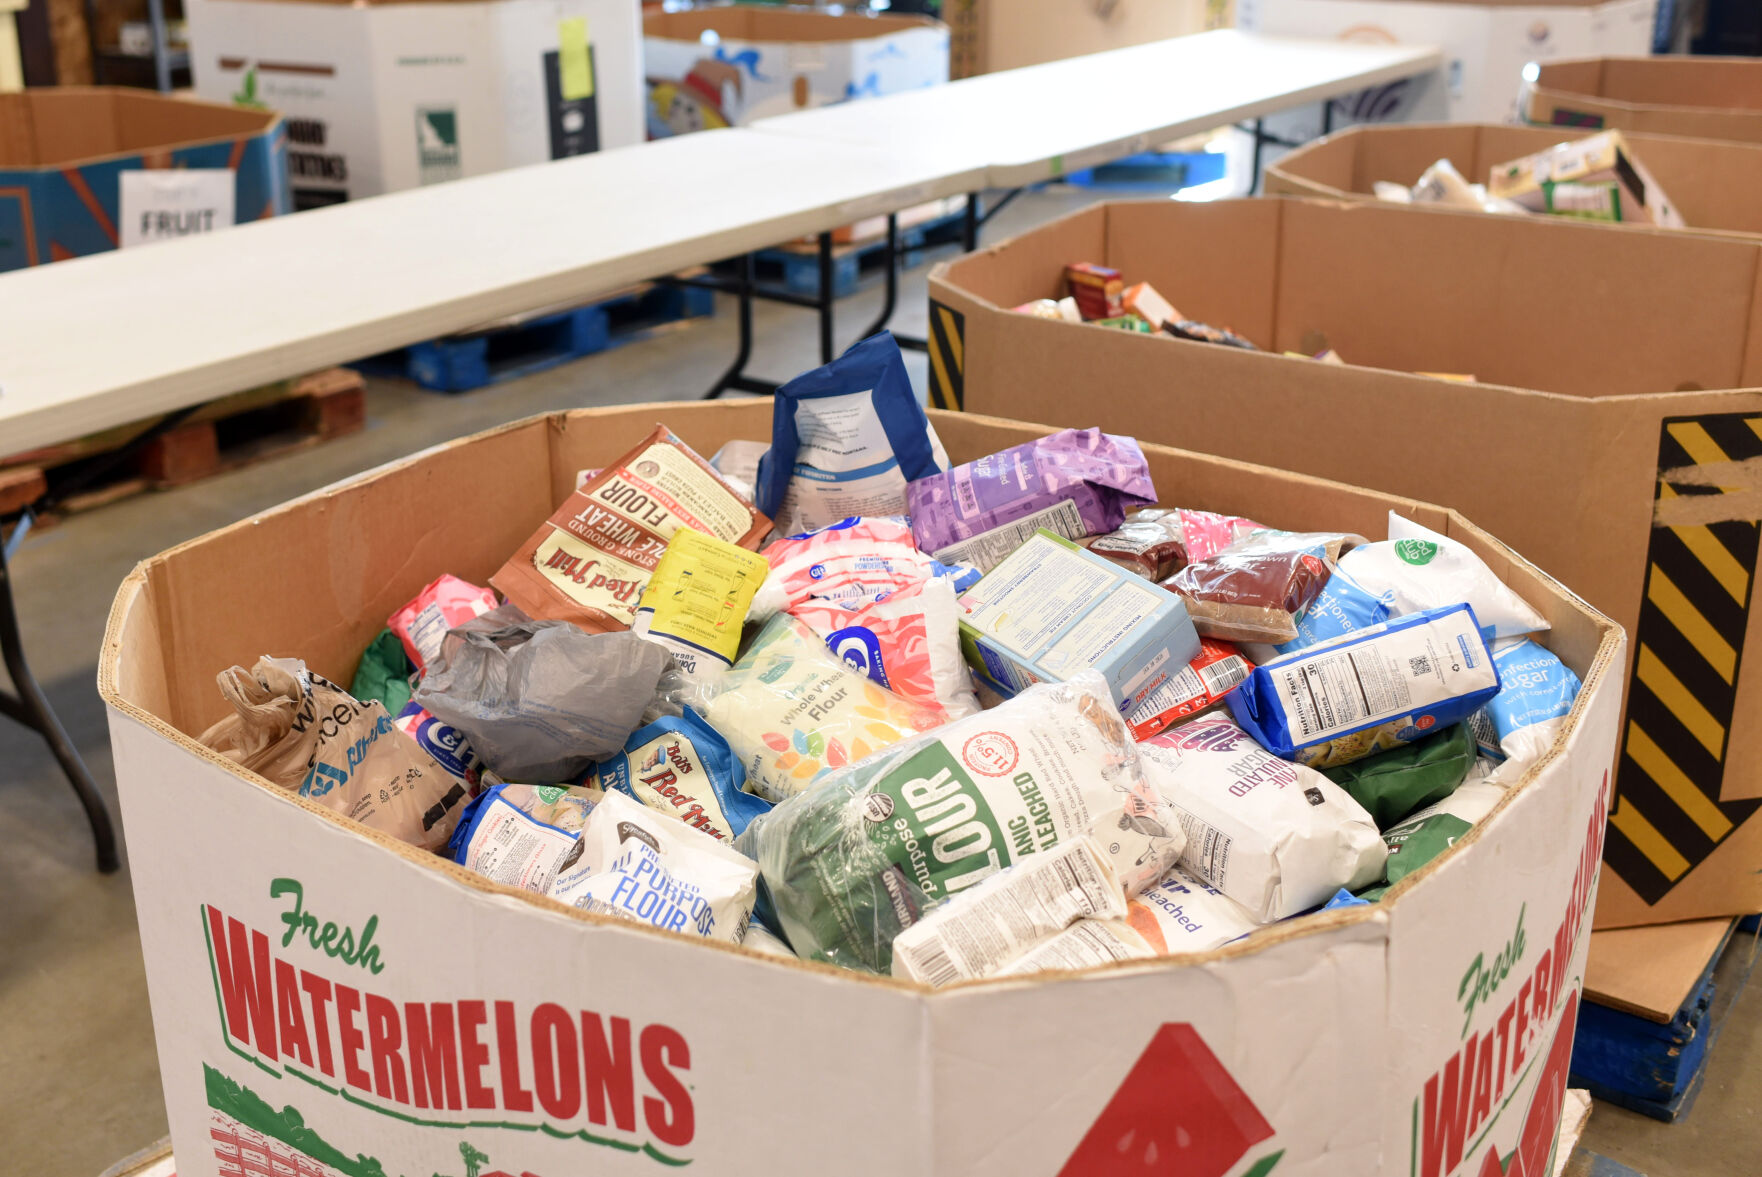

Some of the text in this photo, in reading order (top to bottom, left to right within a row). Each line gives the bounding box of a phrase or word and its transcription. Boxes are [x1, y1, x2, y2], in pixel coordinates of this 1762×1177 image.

[140, 209, 218, 236] FRUIT
[575, 504, 641, 547] WHEAT
[600, 480, 668, 527] FLOUR
[568, 520, 616, 551] GROUND
[616, 542, 657, 567] STONE
[545, 547, 643, 603] Red Mill
[1087, 614, 1141, 663] MIXING INSTRUCTIONS
[1135, 687, 1149, 703] DRY
[1150, 672, 1167, 690] MILK
[1307, 664, 1317, 676] 30
[780, 693, 816, 727] Whole
[814, 671, 846, 694] Whea
[807, 687, 849, 722] Flour
[1286, 672, 1310, 735] Nutrition Facts
[1322, 697, 1334, 728] Calories
[667, 740, 694, 775] Bob's
[972, 738, 1009, 770] 11.5%
[639, 768, 697, 809] Red
[1228, 756, 1275, 798] NULATED
[901, 767, 1002, 892] LOUR
[1012, 771, 1059, 852] LEACHED
[894, 817, 938, 897] purpose
[1008, 815, 1036, 857] ANIC
[1203, 828, 1215, 856] Calories
[1222, 837, 1233, 866] Nutrition
[1053, 858, 1092, 917] Calories 110
[1076, 848, 1098, 891] Nutrition
[610, 851, 715, 937] ALL PURPOSE
[610, 876, 688, 934] FLOUR
[882, 870, 914, 929] KIRKLAND
[270, 878, 385, 975] Fresh
[1421, 768, 1609, 1177] WATERMELONS
[1457, 901, 1528, 1041] Fresh
[207, 903, 696, 1149] WATERMELONS
